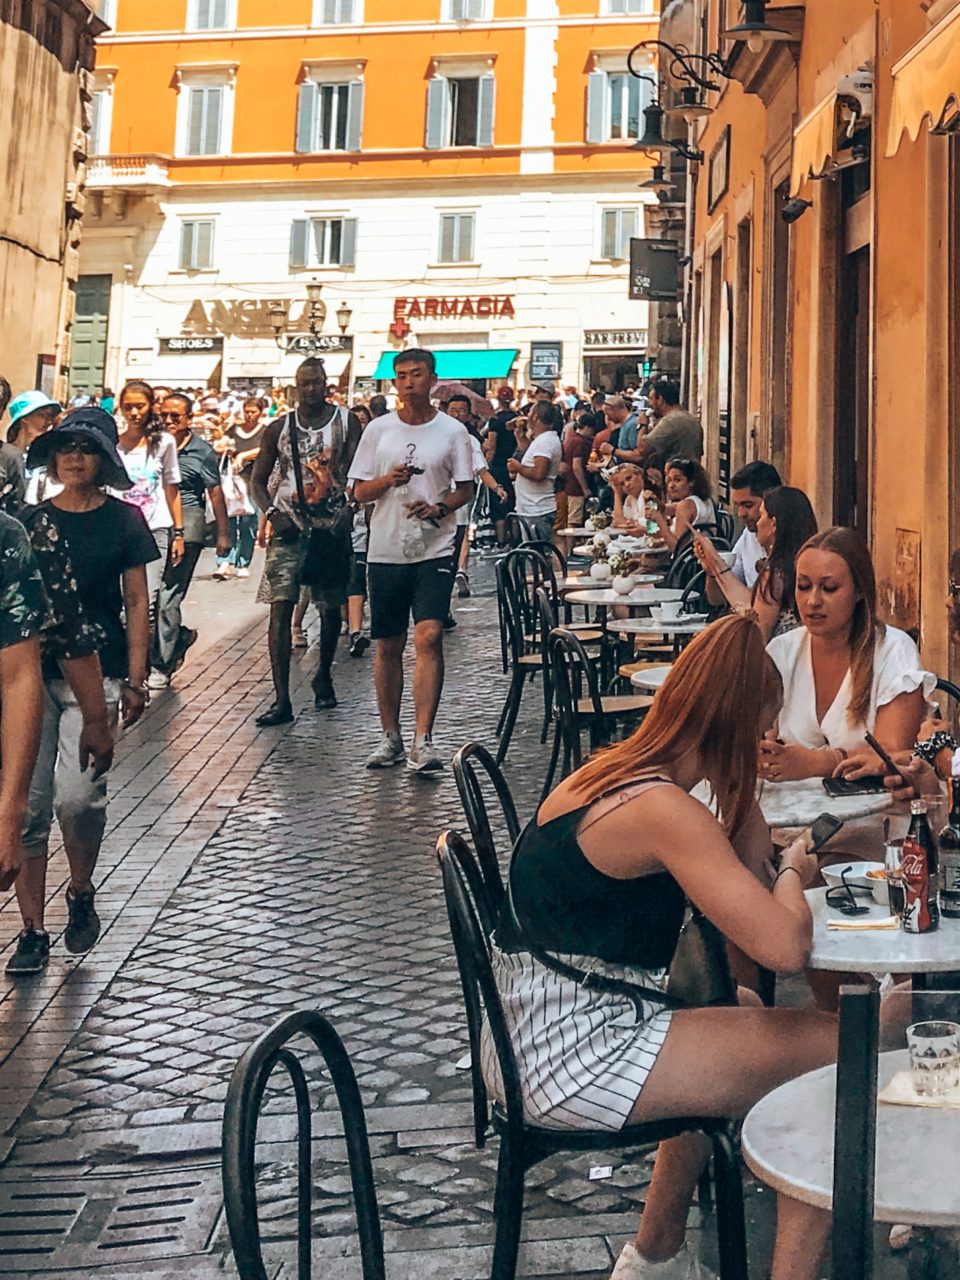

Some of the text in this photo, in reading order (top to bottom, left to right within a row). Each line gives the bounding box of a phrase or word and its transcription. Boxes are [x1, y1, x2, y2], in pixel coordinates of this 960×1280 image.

[394, 297, 515, 319] FARMACIA
[168, 338, 213, 348] SHOES
[585, 331, 645, 344] BAR TREVI
